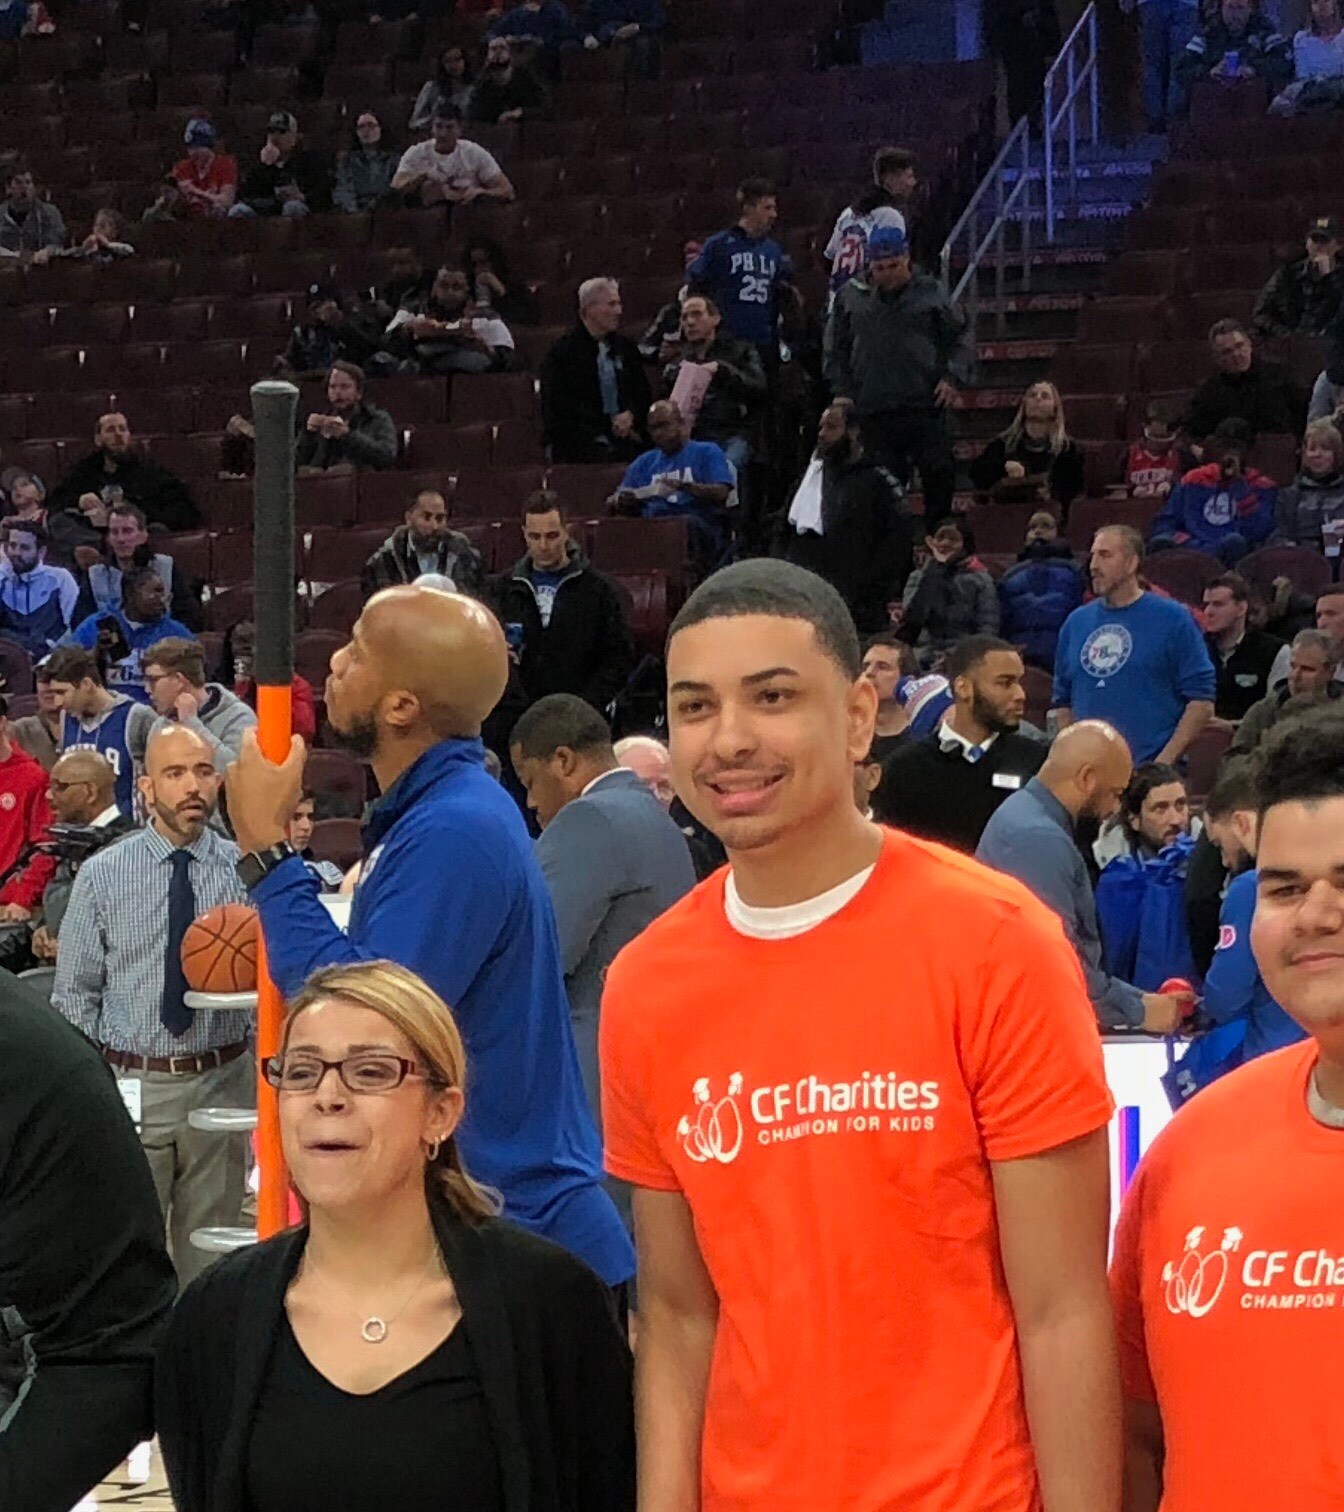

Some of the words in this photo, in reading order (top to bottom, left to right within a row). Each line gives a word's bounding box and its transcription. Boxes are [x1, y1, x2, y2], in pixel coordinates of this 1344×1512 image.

[730, 251, 777, 279] PHLA
[739, 274, 770, 304] 25
[750, 1084, 792, 1124] CF
[796, 1071, 940, 1116] Charities
[889, 1115, 936, 1132] KIDS
[1241, 1251, 1289, 1287] CF
[1240, 1292, 1335, 1309] CHAMPION
